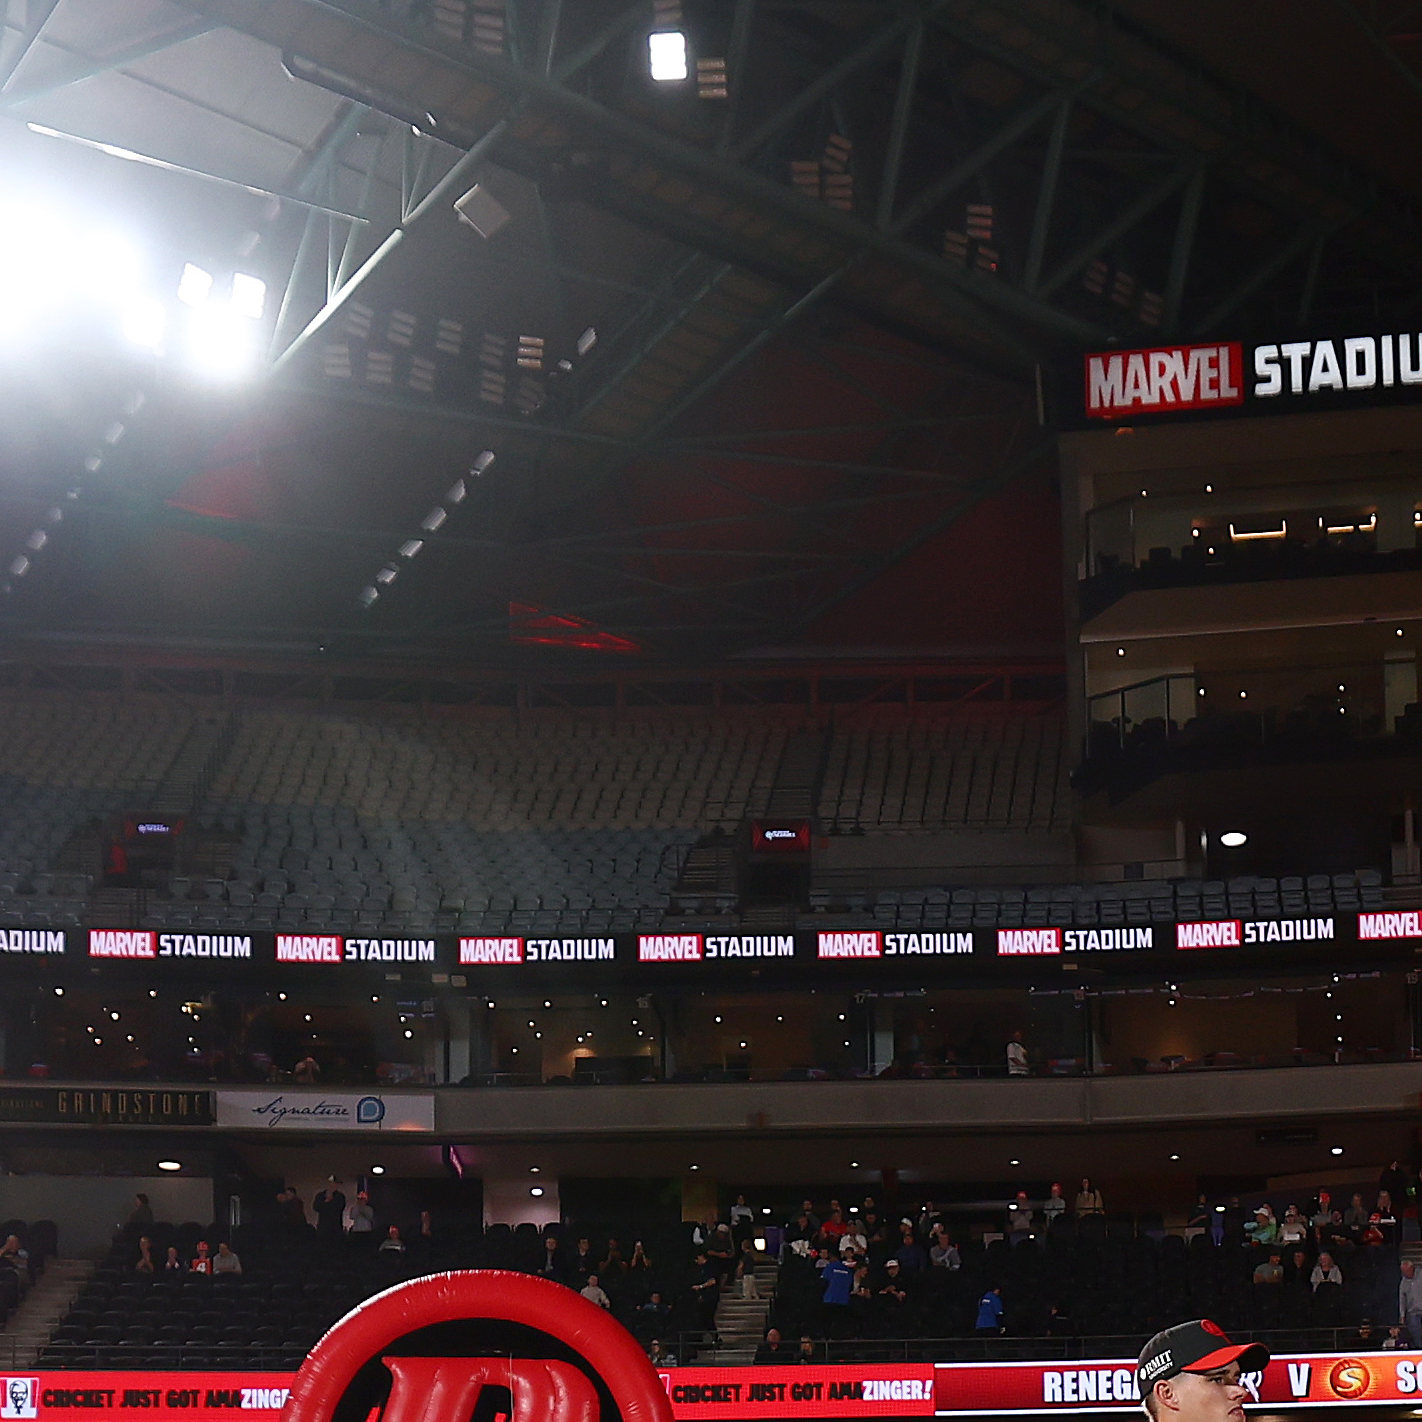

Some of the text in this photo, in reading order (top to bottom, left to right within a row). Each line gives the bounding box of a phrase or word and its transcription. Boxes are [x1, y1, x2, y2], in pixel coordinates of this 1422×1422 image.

[1089, 345, 1239, 409] MARVEL
[1177, 918, 1334, 949] MARVEL STADIUM
[1358, 912, 1422, 939] MARVEL
[89, 931, 251, 958] MARVEL STADIUM
[276, 935, 435, 962] MARVEL STADIUM
[459, 938, 615, 964] MARVEL STADIUM
[639, 935, 794, 961] MARVEL STADIUM
[818, 932, 973, 957] MARVEL STADIUM
[997, 928, 1153, 955] MARVEL STADIUM
[58, 1091, 201, 1116] GRINDSTONE
[252, 1096, 349, 1127] Signature
[1145, 1349, 1172, 1374] RMIT
[673, 1379, 934, 1405] CRICKET JUST GOT AMAZINGER!
[1043, 1363, 1310, 1404] RENEG V
[43, 1387, 290, 1409] CRICKET JUST GOT AMAZING
